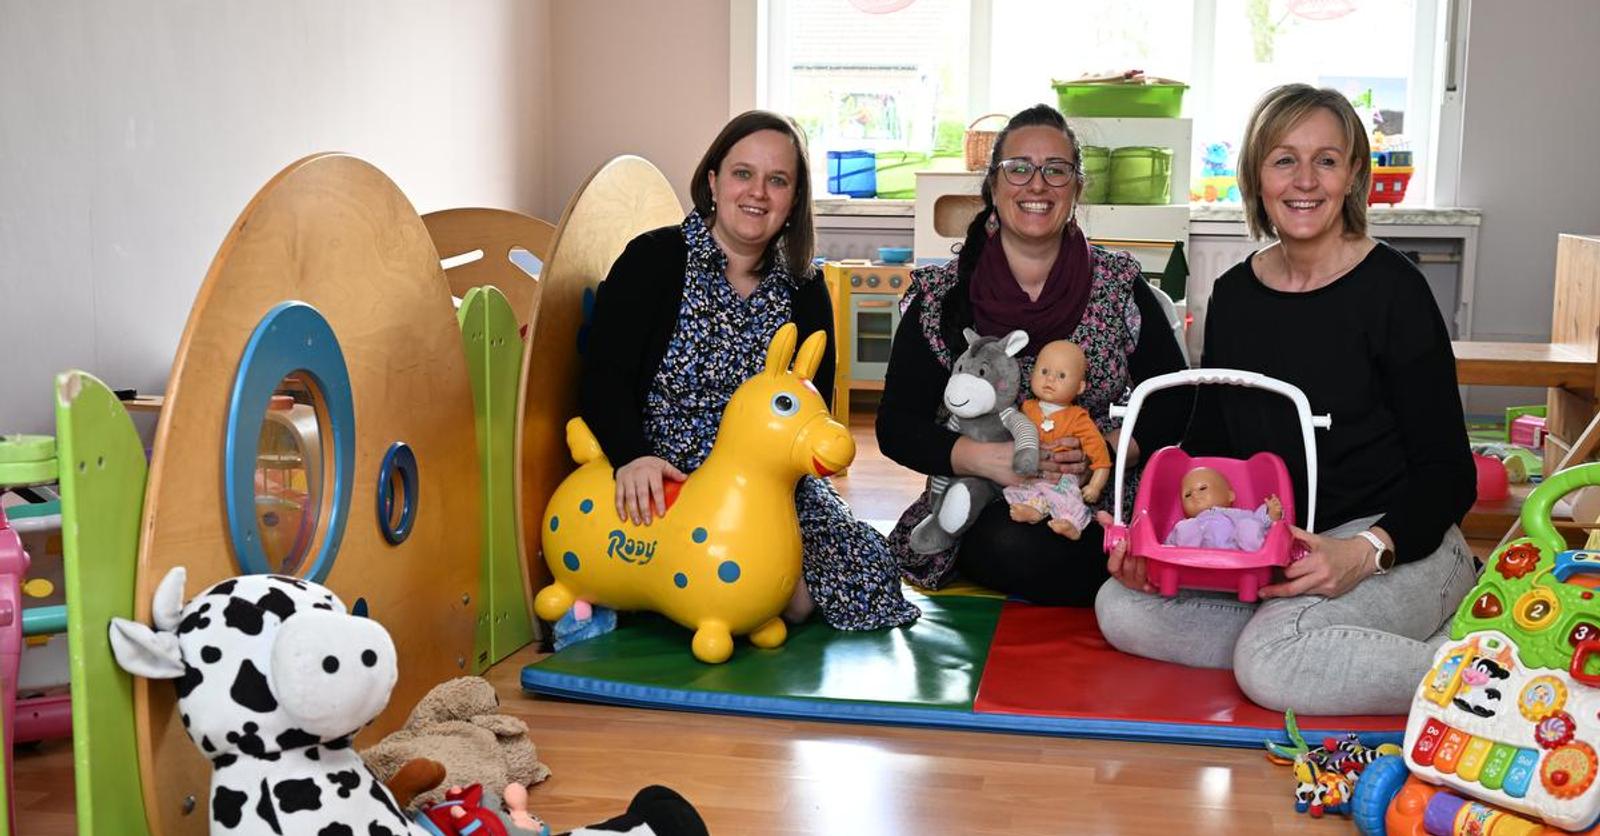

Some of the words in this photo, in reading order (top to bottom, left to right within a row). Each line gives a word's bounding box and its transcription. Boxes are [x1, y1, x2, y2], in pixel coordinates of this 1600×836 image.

[1480, 595, 1488, 608] 1
[1530, 604, 1544, 618] 2
[1574, 625, 1589, 640] 3
[1426, 725, 1440, 737] Do
